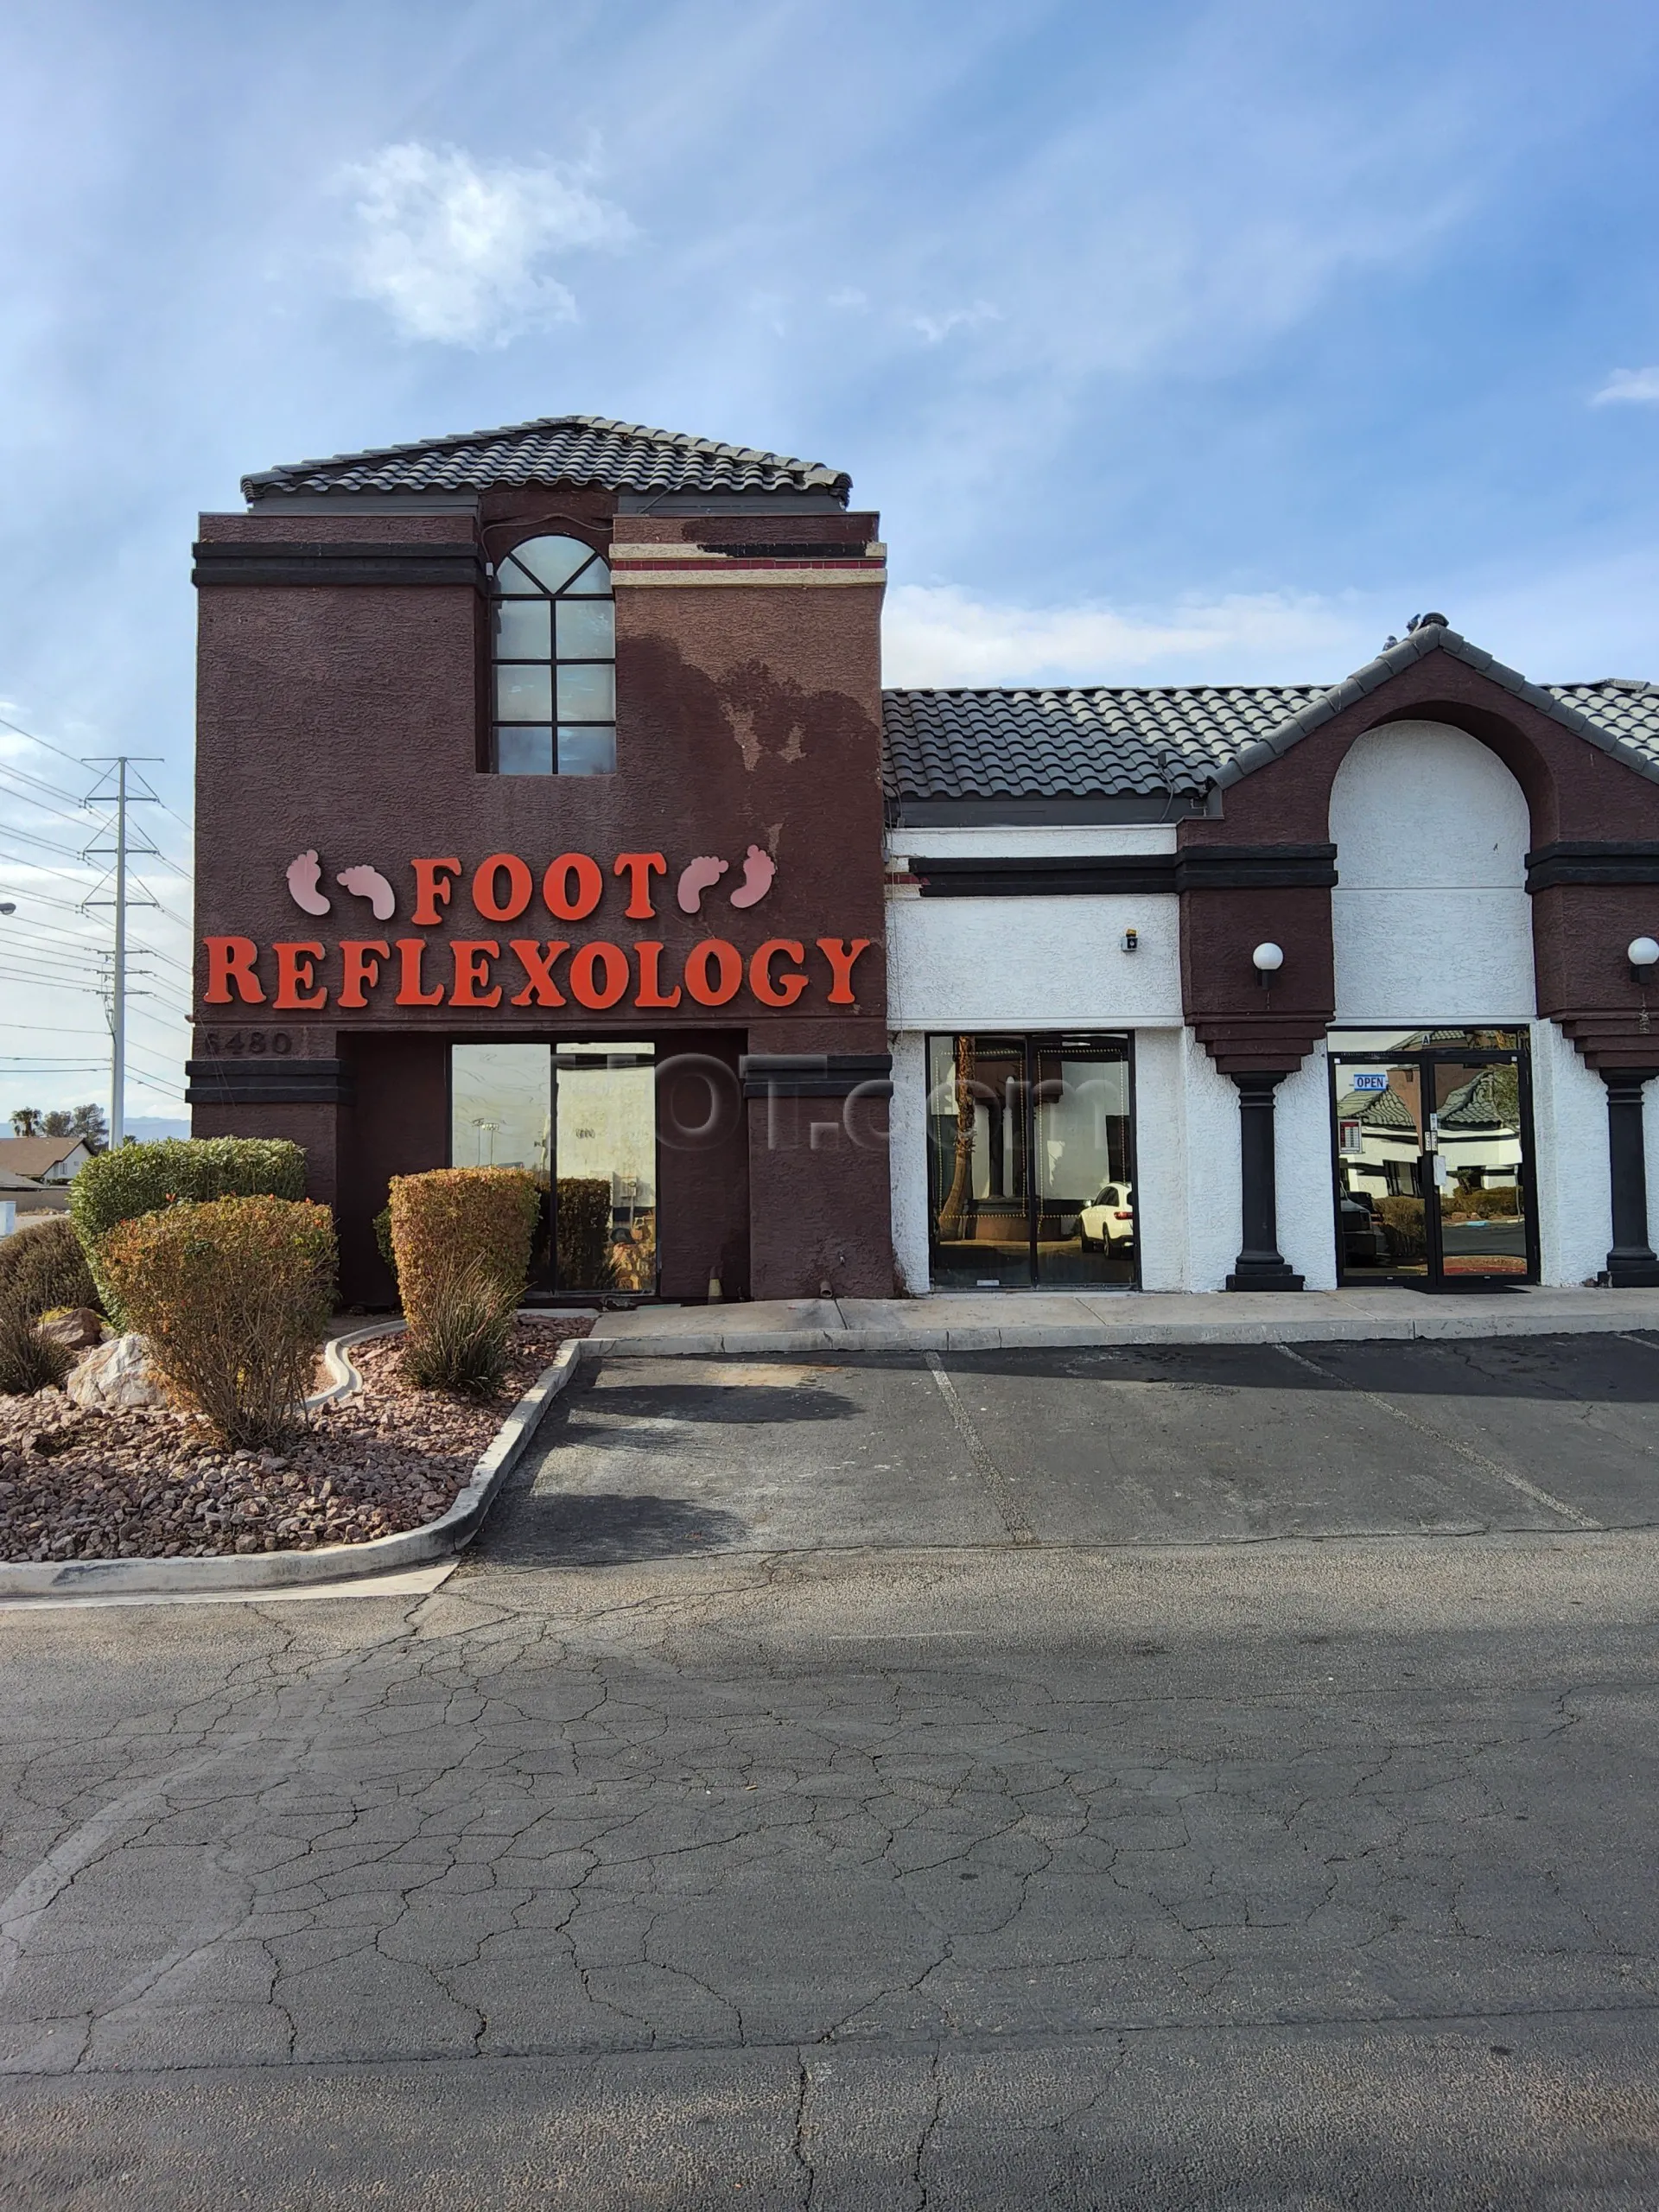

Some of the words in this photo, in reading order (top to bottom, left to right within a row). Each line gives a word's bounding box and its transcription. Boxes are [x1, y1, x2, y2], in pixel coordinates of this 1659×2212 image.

[410, 852, 668, 925] FOOT
[203, 937, 869, 1010] REFLEXOLOGY
[1422, 1035, 1429, 1045] A
[1357, 1077, 1383, 1088] OPEN
